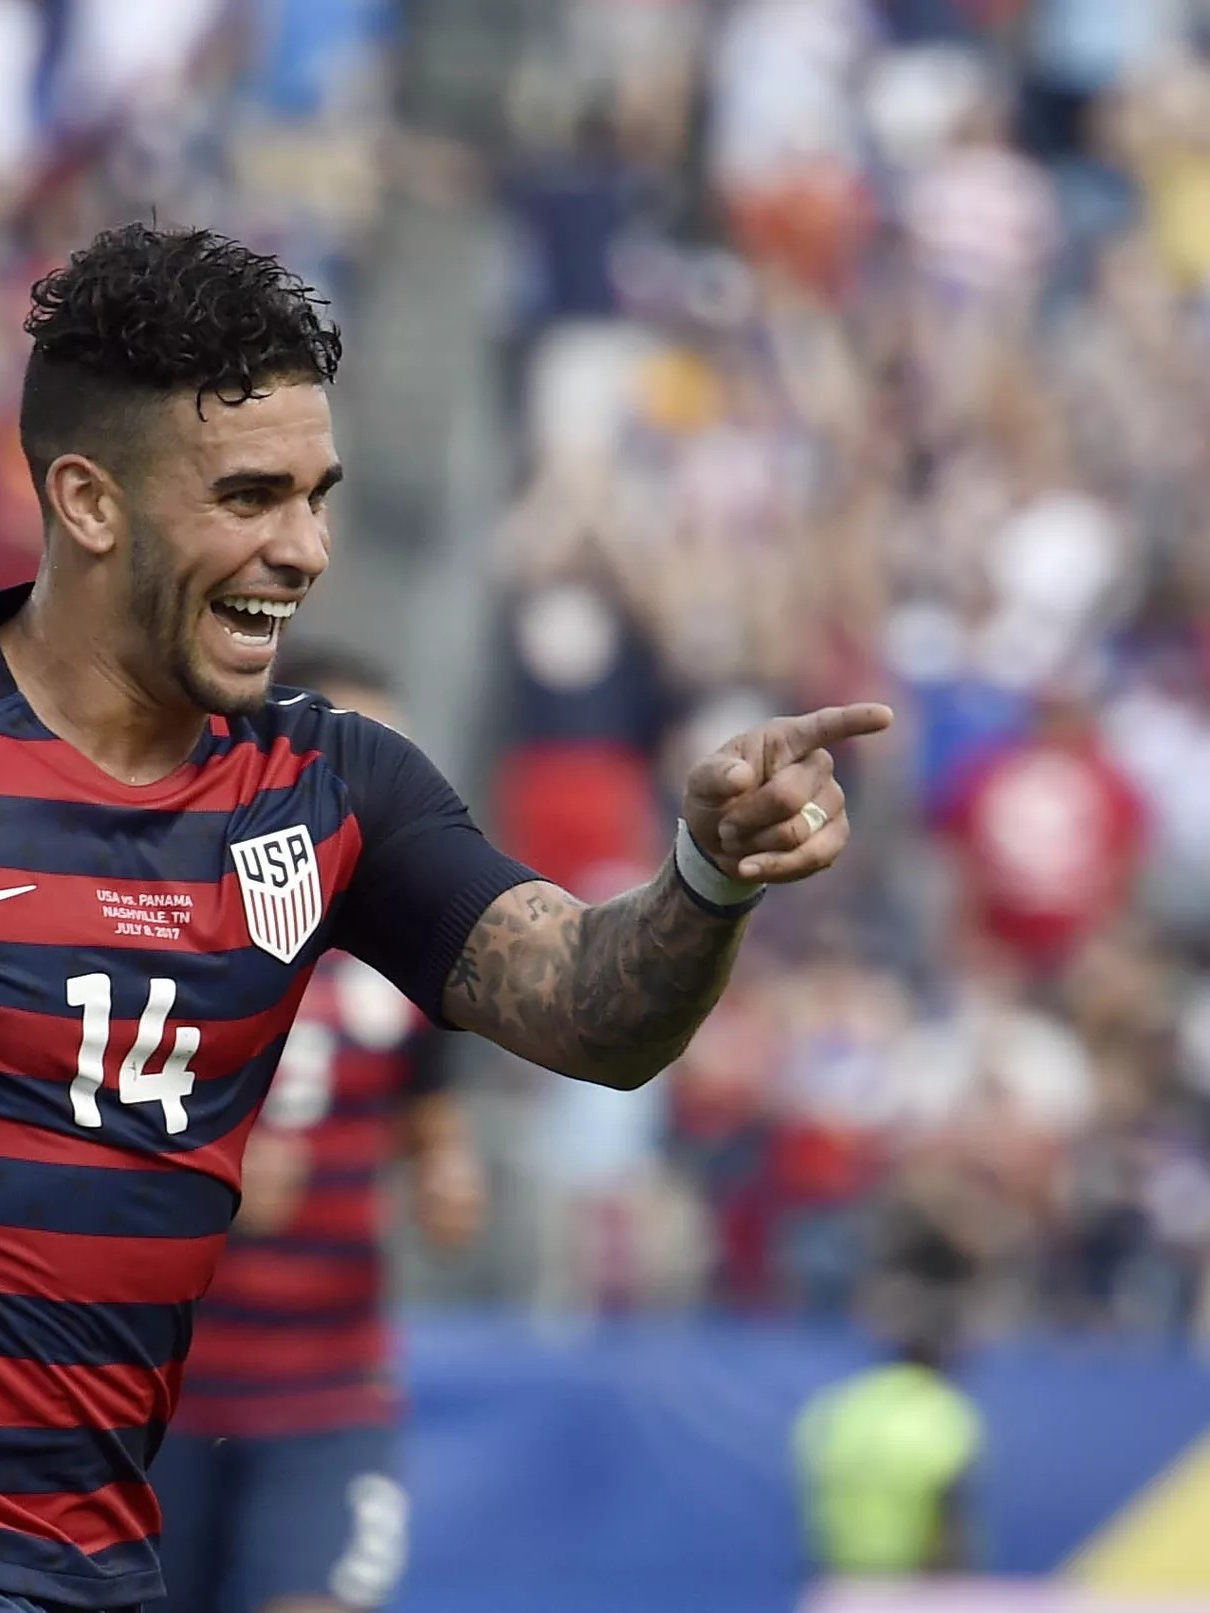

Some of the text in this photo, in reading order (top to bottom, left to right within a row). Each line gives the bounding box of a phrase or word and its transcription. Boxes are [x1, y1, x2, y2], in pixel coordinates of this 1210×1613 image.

[240, 833, 309, 889] USA
[96, 889, 120, 904] USA
[138, 893, 194, 908] PANAMA
[171, 911, 190, 924] TN
[114, 922, 142, 936] JULY
[154, 926, 180, 940] 2017
[66, 972, 202, 1135] 14
